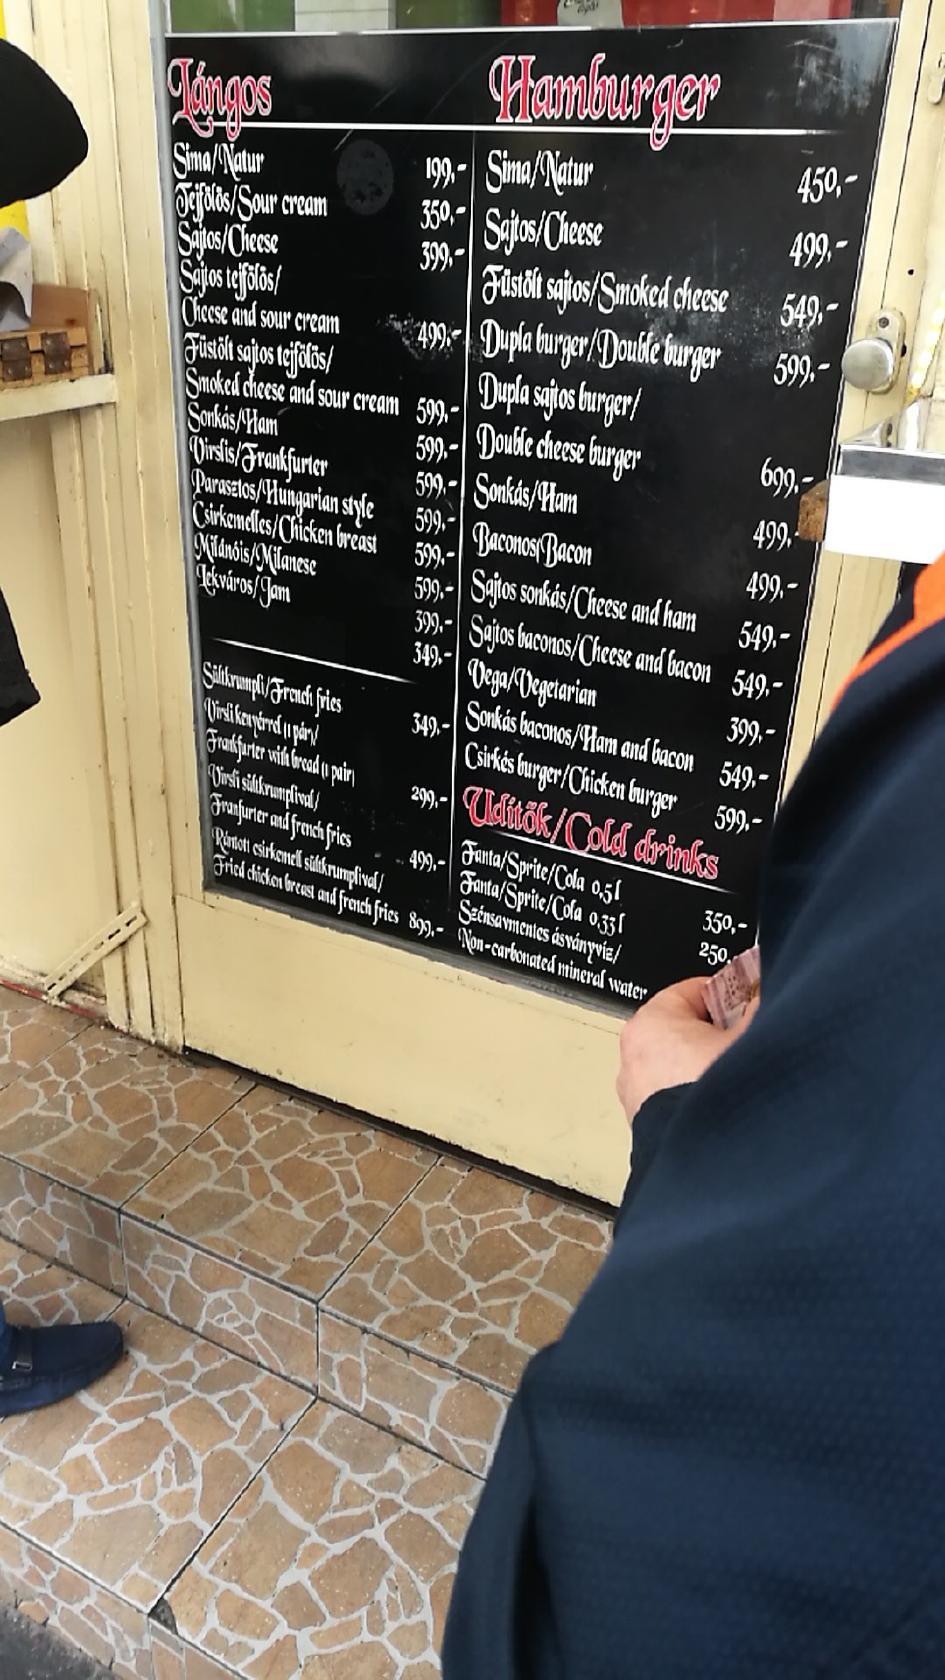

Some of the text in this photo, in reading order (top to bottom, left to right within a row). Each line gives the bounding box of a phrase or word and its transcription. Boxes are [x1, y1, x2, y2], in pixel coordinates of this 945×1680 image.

[168, 58, 272, 141] Lángos
[489, 53, 721, 151] Hamburger
[173, 142, 264, 181] Sima/Natur
[426, 156, 467, 189] 199,-
[486, 150, 593, 195] Sima/Natur
[175, 181, 328, 222] Tejfölös/Sour cream
[797, 166, 858, 204] 450,-
[420, 199, 467, 230] 350,-
[484, 207, 603, 255] Sajtos/Cheese
[178, 221, 279, 261] Sajtos/Cheese
[420, 241, 466, 272] 399,-
[789, 231, 848, 269] 499,-
[179, 258, 282, 301] Sajtos tejfölös/
[482, 263, 729, 316] Füstölt sajtos/Smoked cheese
[182, 298, 340, 335] Cheese and sour cream
[780, 293, 839, 328] 549,-
[183, 332, 334, 380] Füstölt sajtos tejfölös/
[418, 321, 462, 351] 499,-
[480, 318, 722, 383] Dupla burger/Double burger
[774, 353, 831, 387] 599,-
[185, 367, 400, 416] Smoked cheese and sour cream
[416, 397, 460, 426] 599,-
[479, 373, 641, 428] Dupla sajtos burger/
[187, 403, 278, 436] Sonkás/Ham
[189, 435, 328, 483] Virslis/Frankfurter
[416, 435, 459, 464] 599,-
[476, 423, 642, 482] Double cheese burger
[191, 468, 374, 528] Parasztos/Hungarian style
[415, 472, 458, 500] 599,-
[474, 472, 578, 515] Sonkás/Ham
[760, 457, 814, 499] 699,-
[193, 500, 378, 554] Csirkemelles/Chicken breast
[414, 507, 456, 535] 599,-
[752, 520, 799, 553] 499,
[414, 543, 455, 568] 599,-
[196, 564, 291, 609] Lekváros/Jam
[414, 577, 455, 602] 599,-
[471, 568, 697, 633] Sajtos sonkás/Cheese and ham
[746, 571, 799, 604] 499,-
[414, 610, 453, 634] 399,-
[738, 622, 791, 653] 549,-
[413, 642, 452, 668] 349,-
[469, 614, 712, 684] Sajtos baconos/Cheese and bacon
[202, 661, 342, 718] Sültkrumpli/French fries
[468, 658, 597, 708] Vega/Vegetarian
[731, 671, 783, 701] 549,-
[204, 699, 234, 724] Virsli
[235, 702, 282, 739] kenyérrel
[411, 712, 450, 737] 349,-
[465, 701, 694, 772] Sonkás baconos/Ham and bacon
[727, 717, 777, 746] 399,-
[206, 729, 266, 770] Frankfurter
[267, 747, 289, 768] with
[290, 752, 320, 775] bread
[208, 763, 320, 812] Virsli sültkrumplival/
[465, 742, 678, 819] Csirkés burger/Chicken burger
[719, 762, 770, 791] 549,-
[411, 787, 448, 809] 299,-
[210, 792, 352, 851] Franfurter and french fries
[714, 806, 762, 834] 599,-
[212, 828, 384, 894] Rántott csirkemell sültkrumplival/
[409, 850, 446, 872] 499,-
[462, 839, 585, 891] Fanta/Sprite/Cola
[634, 833, 720, 880] drinks
[213, 855, 399, 927] Fried chicken breast and french fries
[460, 870, 583, 923] Fanta/Sprite/Cola
[408, 912, 444, 938] 899,-
[458, 899, 622, 965] Szénsavmentes ásványvíz/
[703, 910, 748, 935] 350,-
[458, 927, 648, 1000] Non-carbonated mineral water
